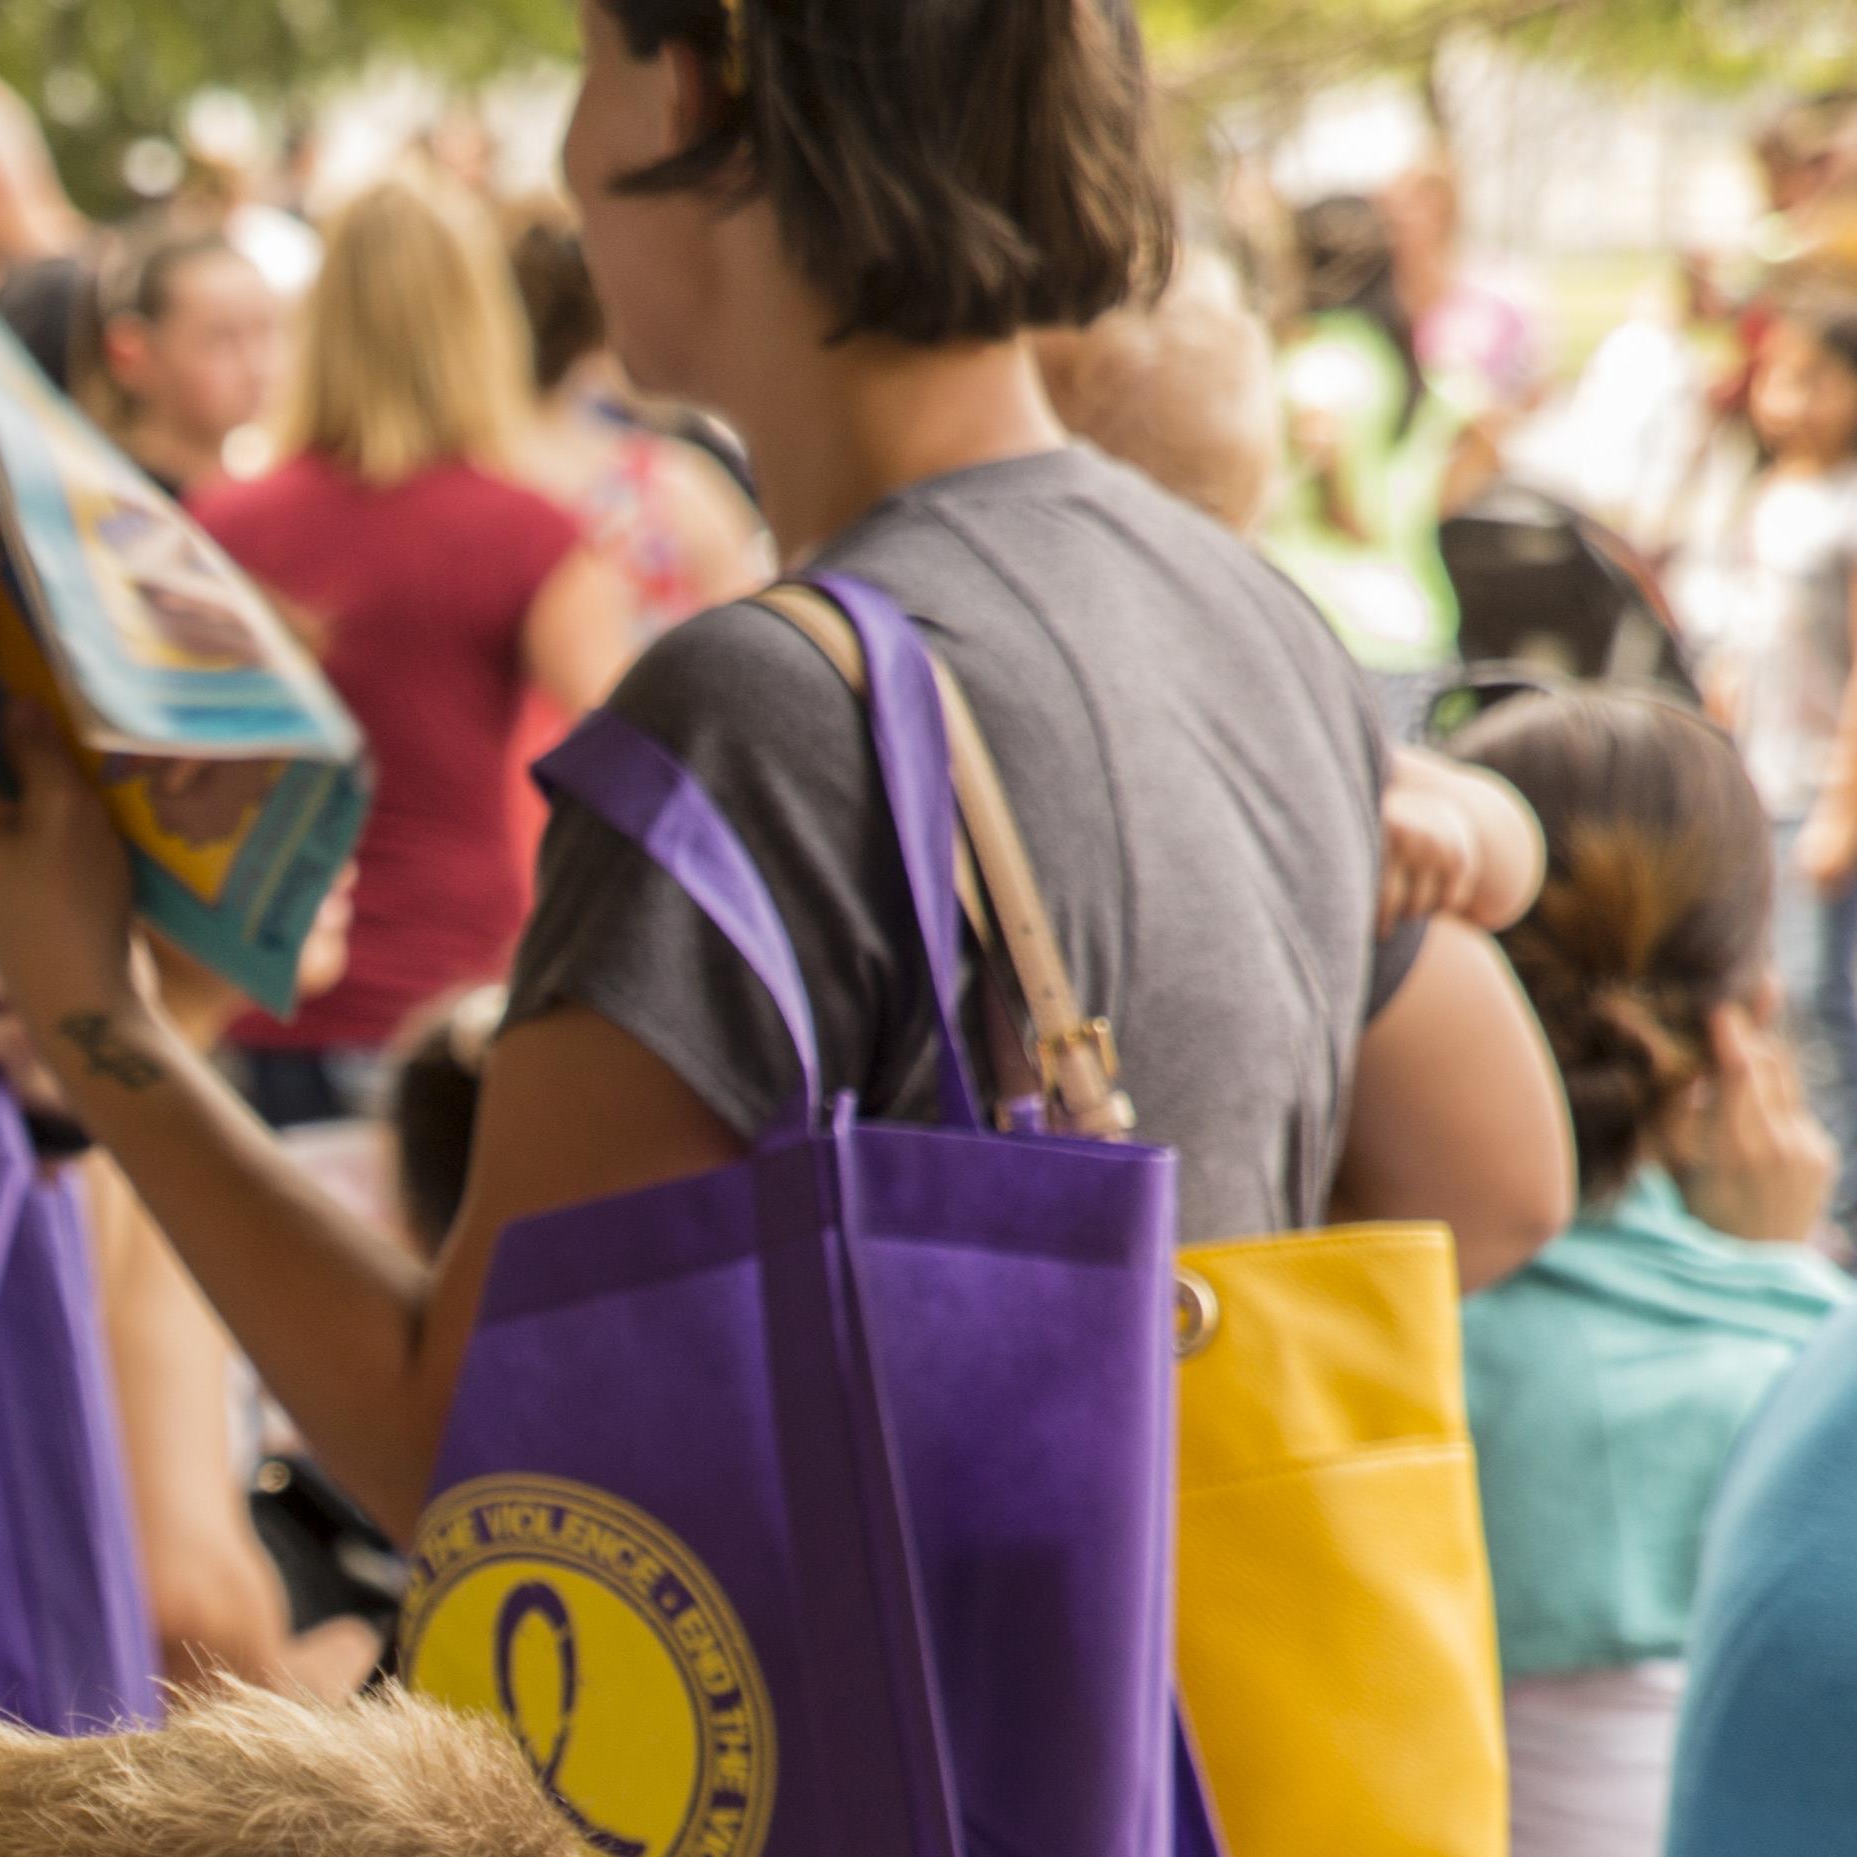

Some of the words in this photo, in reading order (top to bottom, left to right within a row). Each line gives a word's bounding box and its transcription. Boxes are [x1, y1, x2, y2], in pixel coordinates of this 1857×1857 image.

[483, 1500, 665, 1600] VIOLENCE
[672, 1604, 738, 1698] END
[711, 1706, 752, 1792] THE
